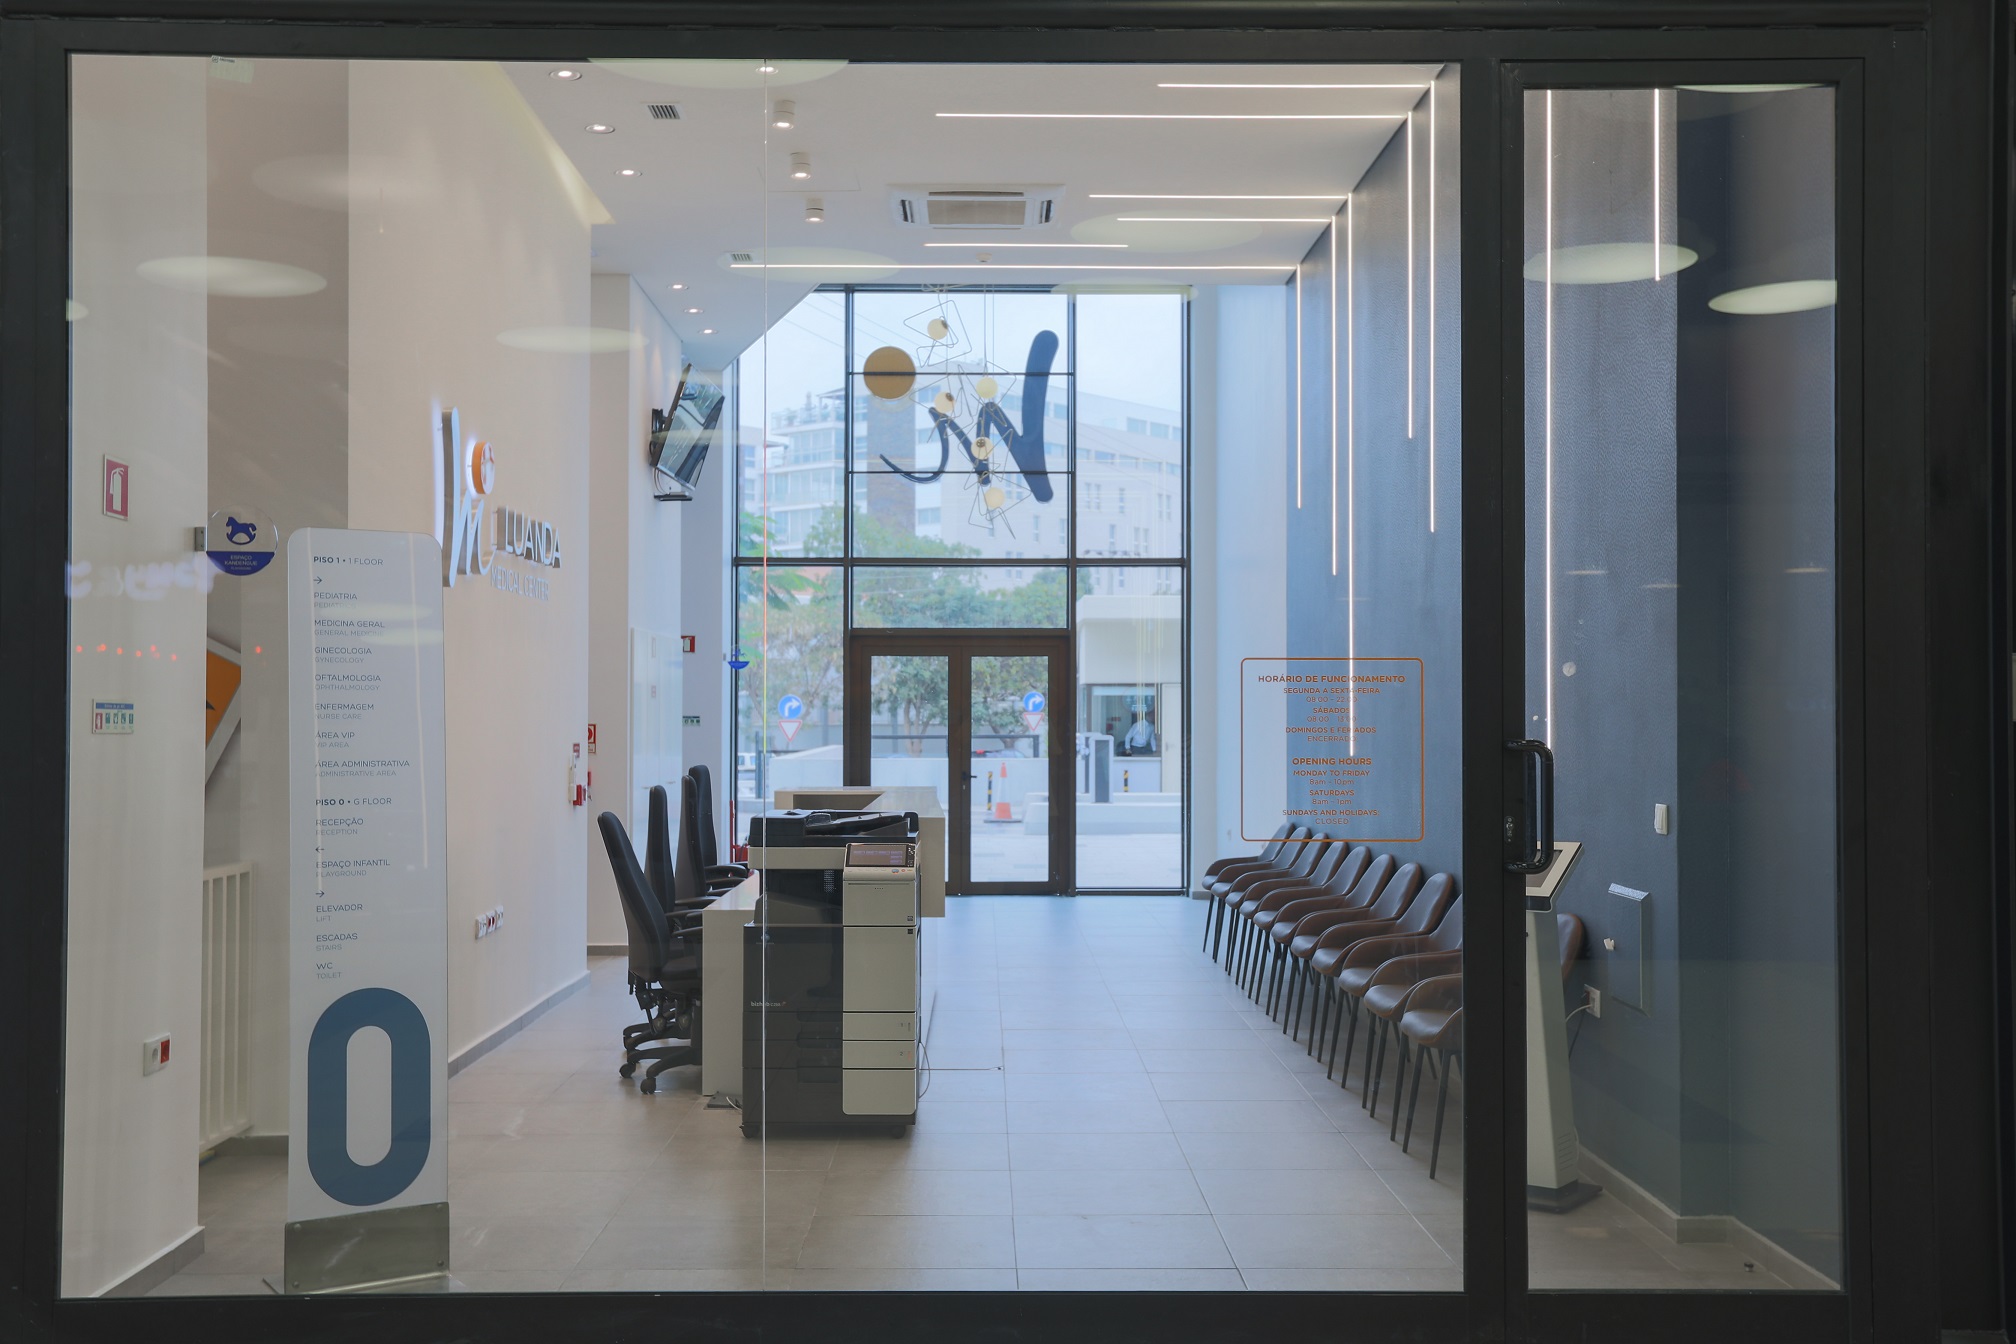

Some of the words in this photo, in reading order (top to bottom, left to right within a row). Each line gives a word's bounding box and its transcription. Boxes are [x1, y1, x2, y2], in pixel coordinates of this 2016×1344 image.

[503, 505, 562, 568] LUANDA
[490, 563, 523, 596] MEDICAL
[524, 575, 549, 600] CENTER
[1258, 674, 1302, 682] HORÁRIO
[315, 730, 339, 738] ÁREA
[316, 818, 364, 826] RECEPÇÃO
[316, 904, 363, 913] ELEVADOR
[316, 933, 358, 942] ESCADAS
[308, 988, 431, 1206] 0
